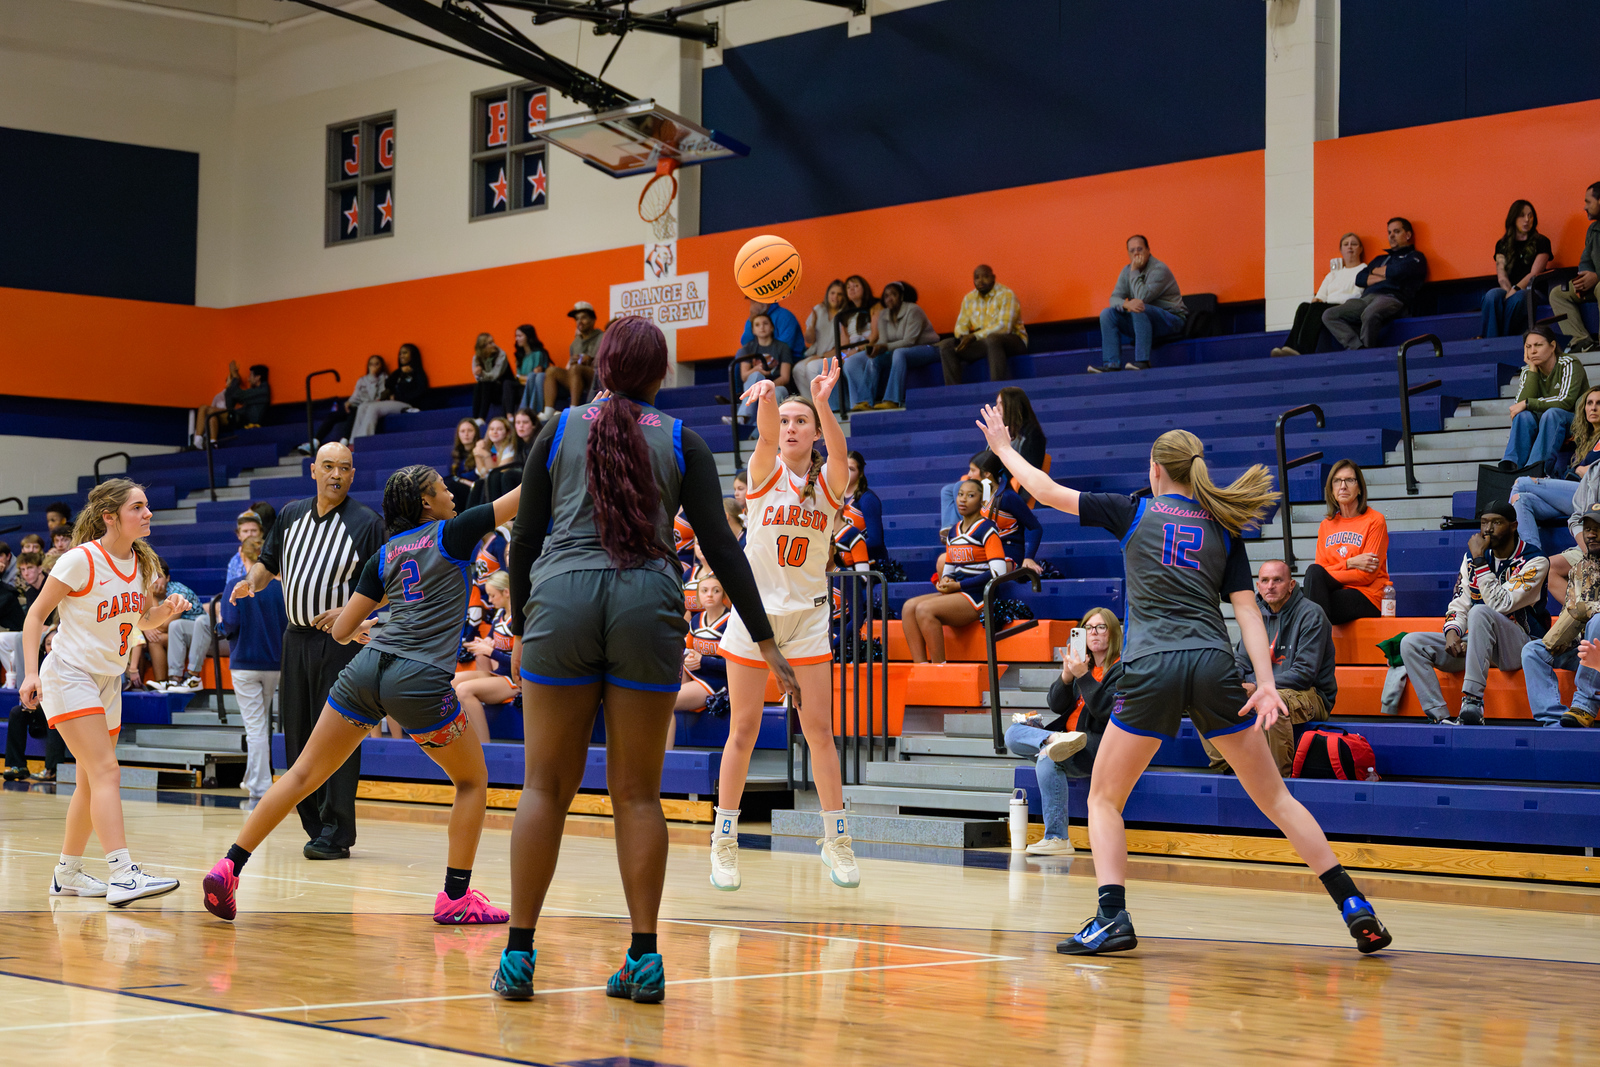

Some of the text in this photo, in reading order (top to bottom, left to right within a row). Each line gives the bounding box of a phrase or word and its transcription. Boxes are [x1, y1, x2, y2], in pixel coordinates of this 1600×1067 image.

[621, 281, 699, 309] ORANGE &
[754, 268, 795, 296] Wilson
[658, 300, 706, 324] CREW
[762, 505, 828, 533] CARSON
[776, 534, 810, 567] 10
[1162, 522, 1205, 571] 12
[1325, 531, 1363, 548] COUGARS
[400, 559, 425, 603] 2
[96, 591, 147, 623] CARSO
[118, 622, 133, 656] 3
